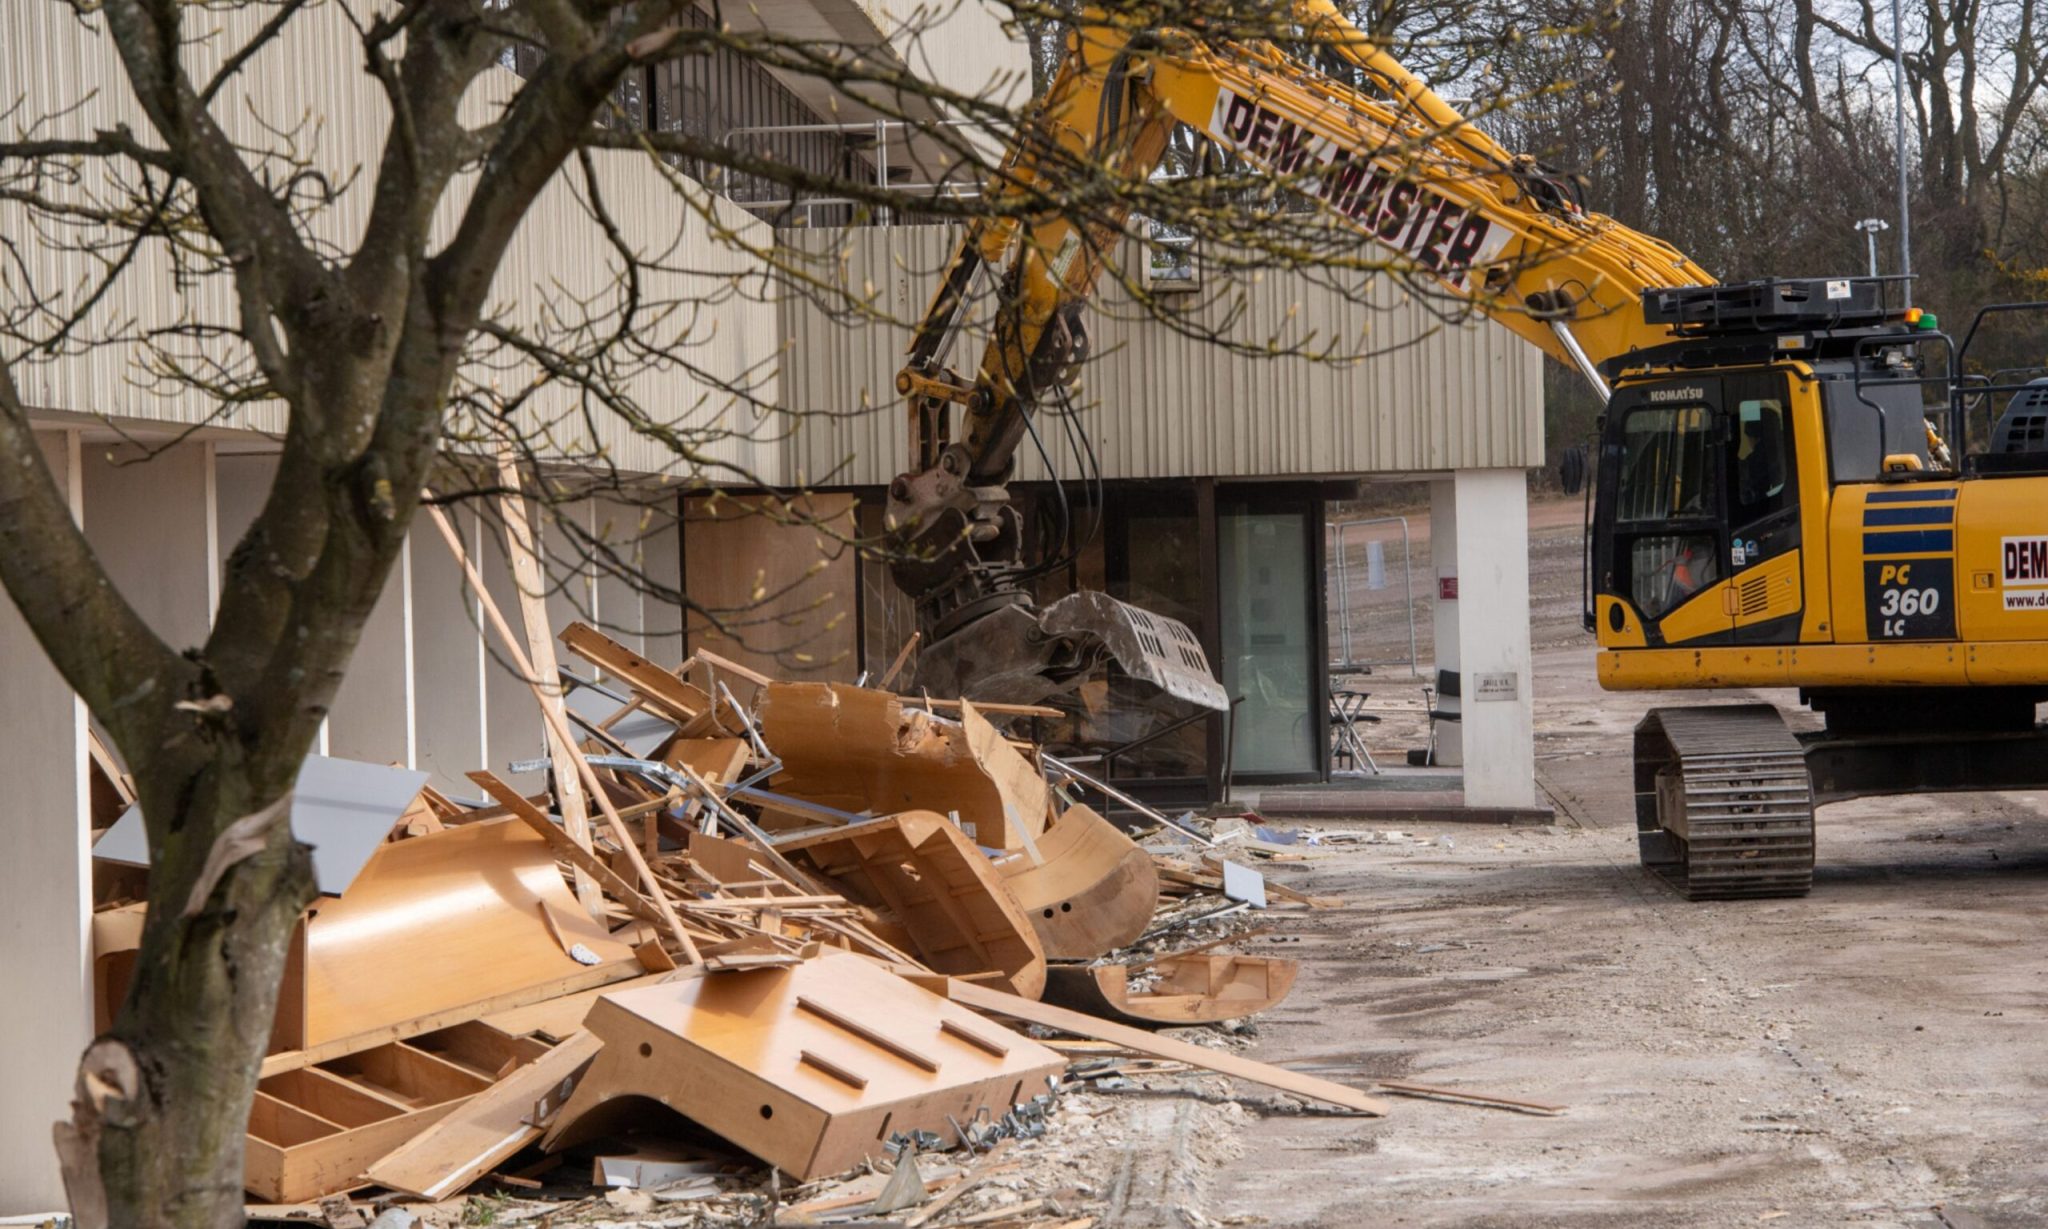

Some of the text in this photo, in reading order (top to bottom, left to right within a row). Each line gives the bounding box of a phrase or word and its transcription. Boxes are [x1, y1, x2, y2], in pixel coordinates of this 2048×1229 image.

[1651, 387, 1703, 401] KOMATSU
[1880, 565, 1911, 585] PC
[1880, 588, 1939, 616] 360
[1884, 620, 1905, 636] LC
